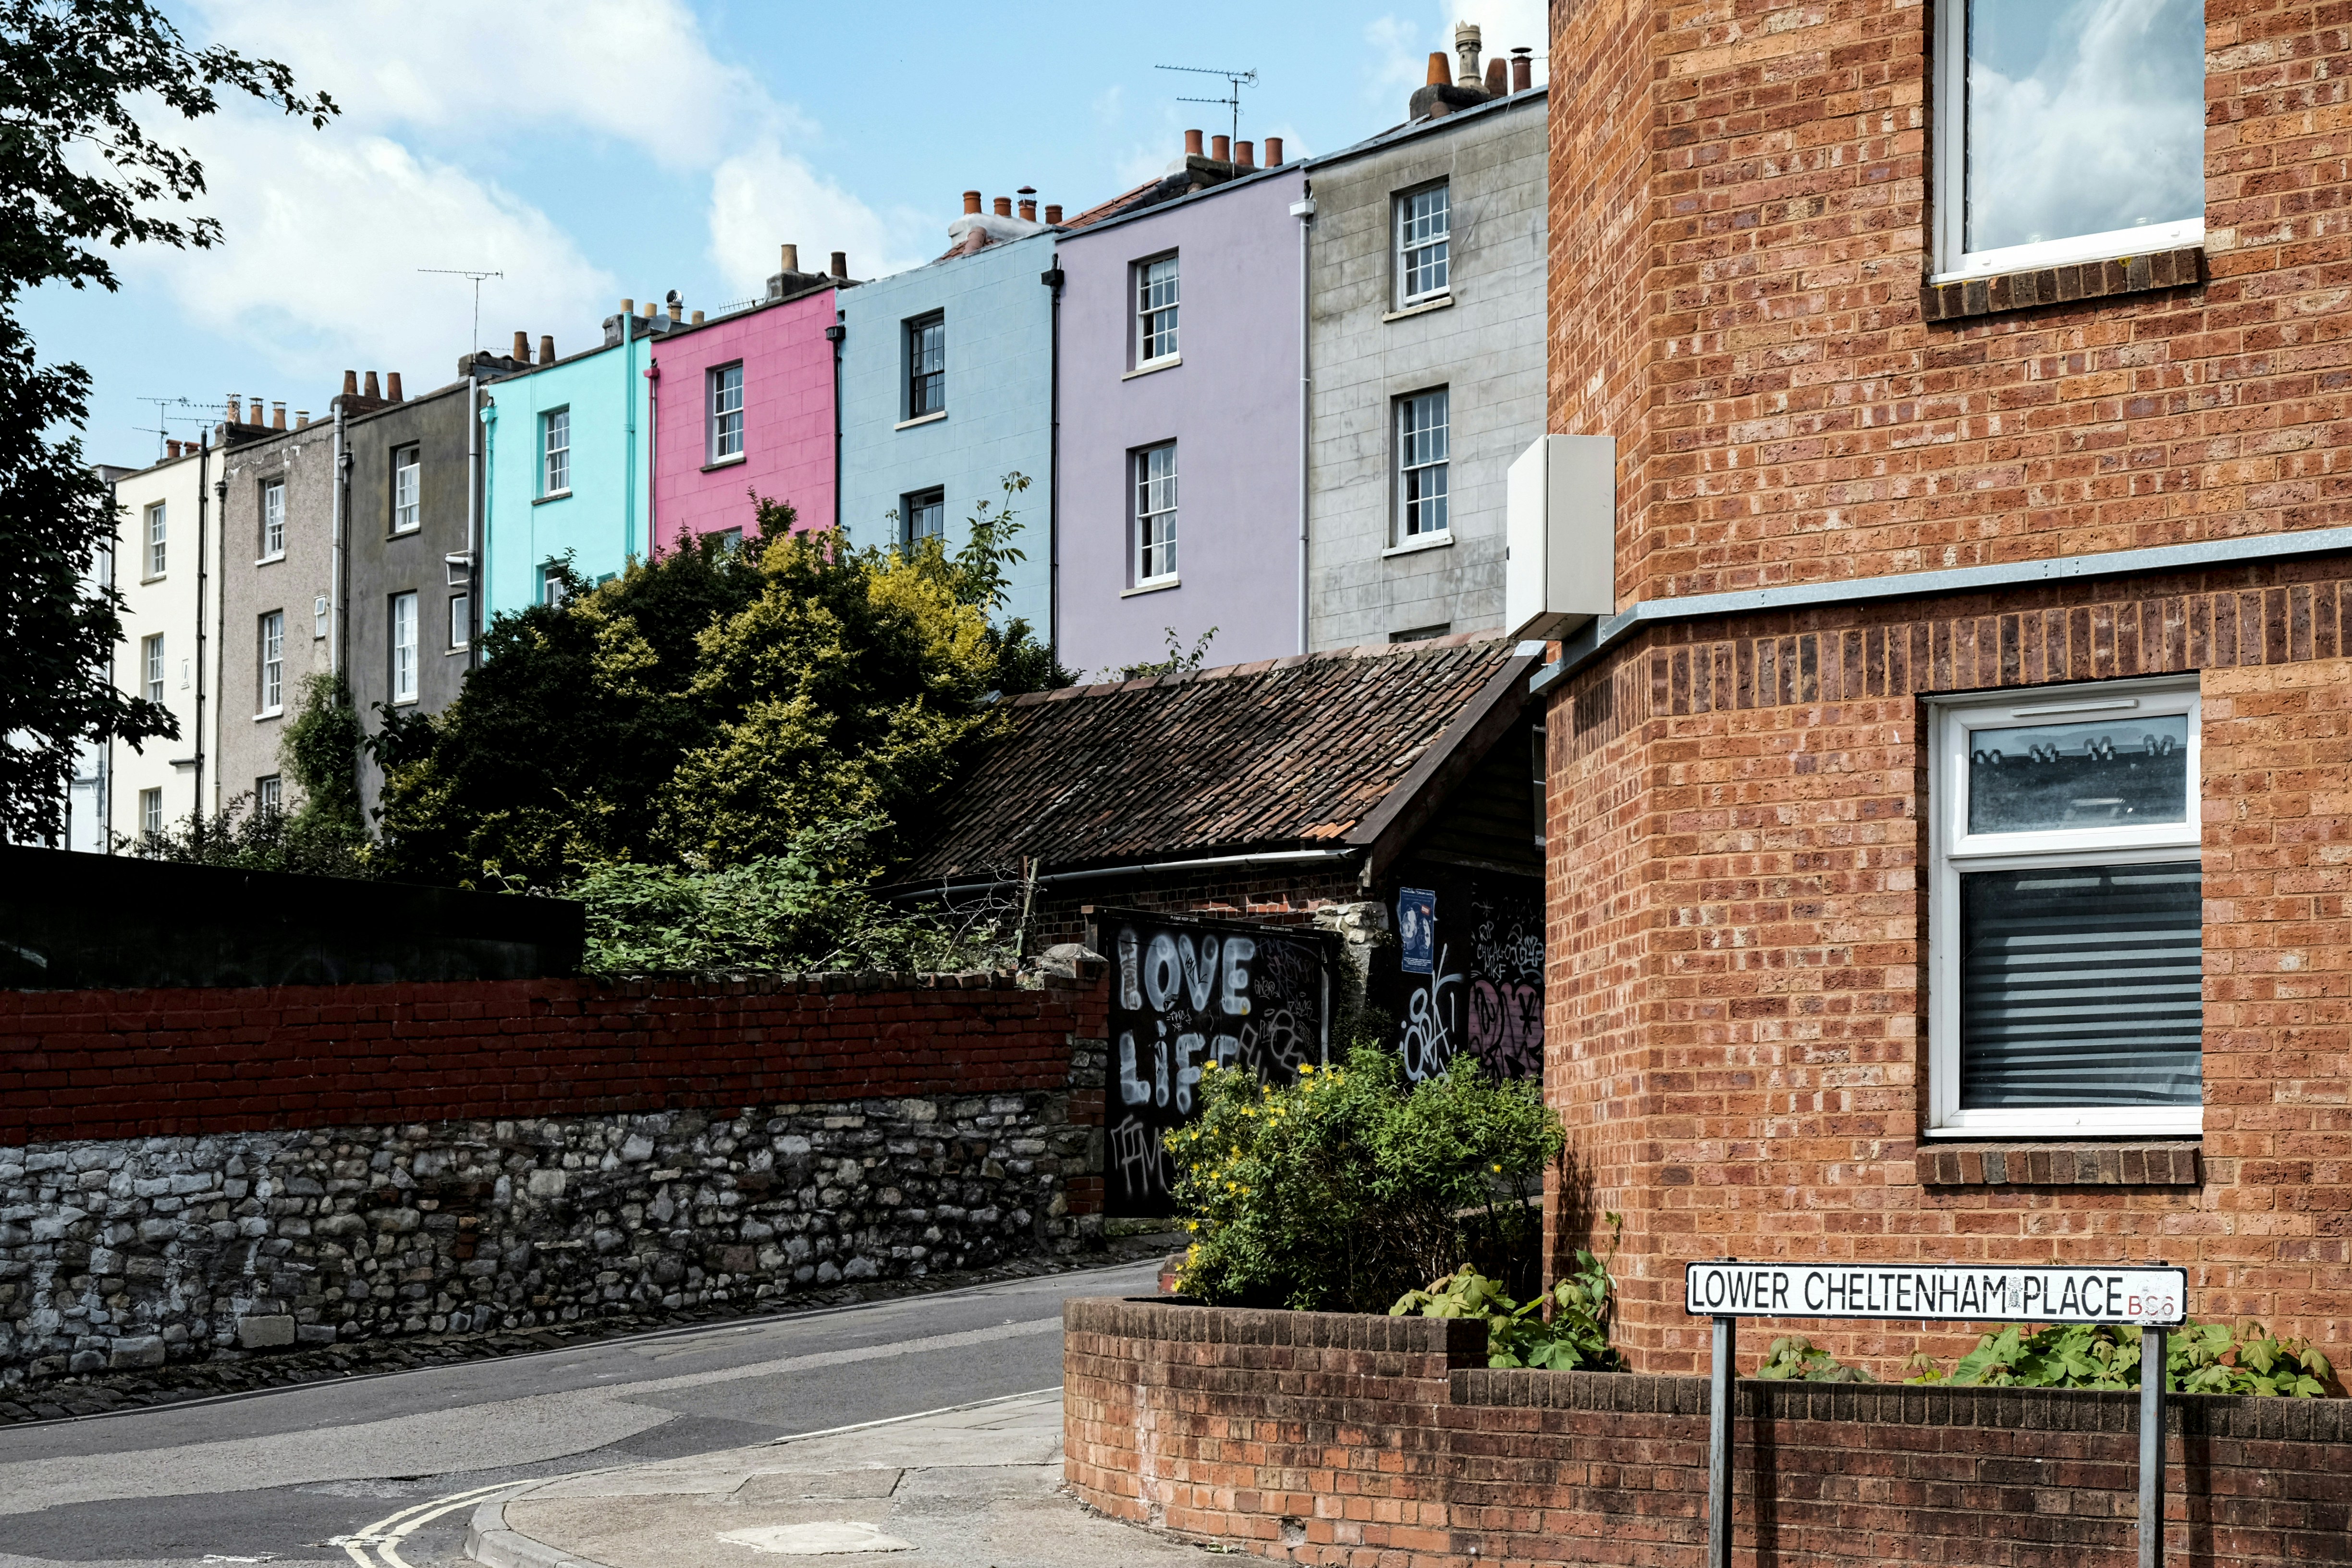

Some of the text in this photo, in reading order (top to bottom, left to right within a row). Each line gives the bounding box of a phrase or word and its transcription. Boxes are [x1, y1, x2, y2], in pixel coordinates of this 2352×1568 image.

[1692, 1270, 2174, 1317] LOWER CHELTENHAM PLACE BS6
